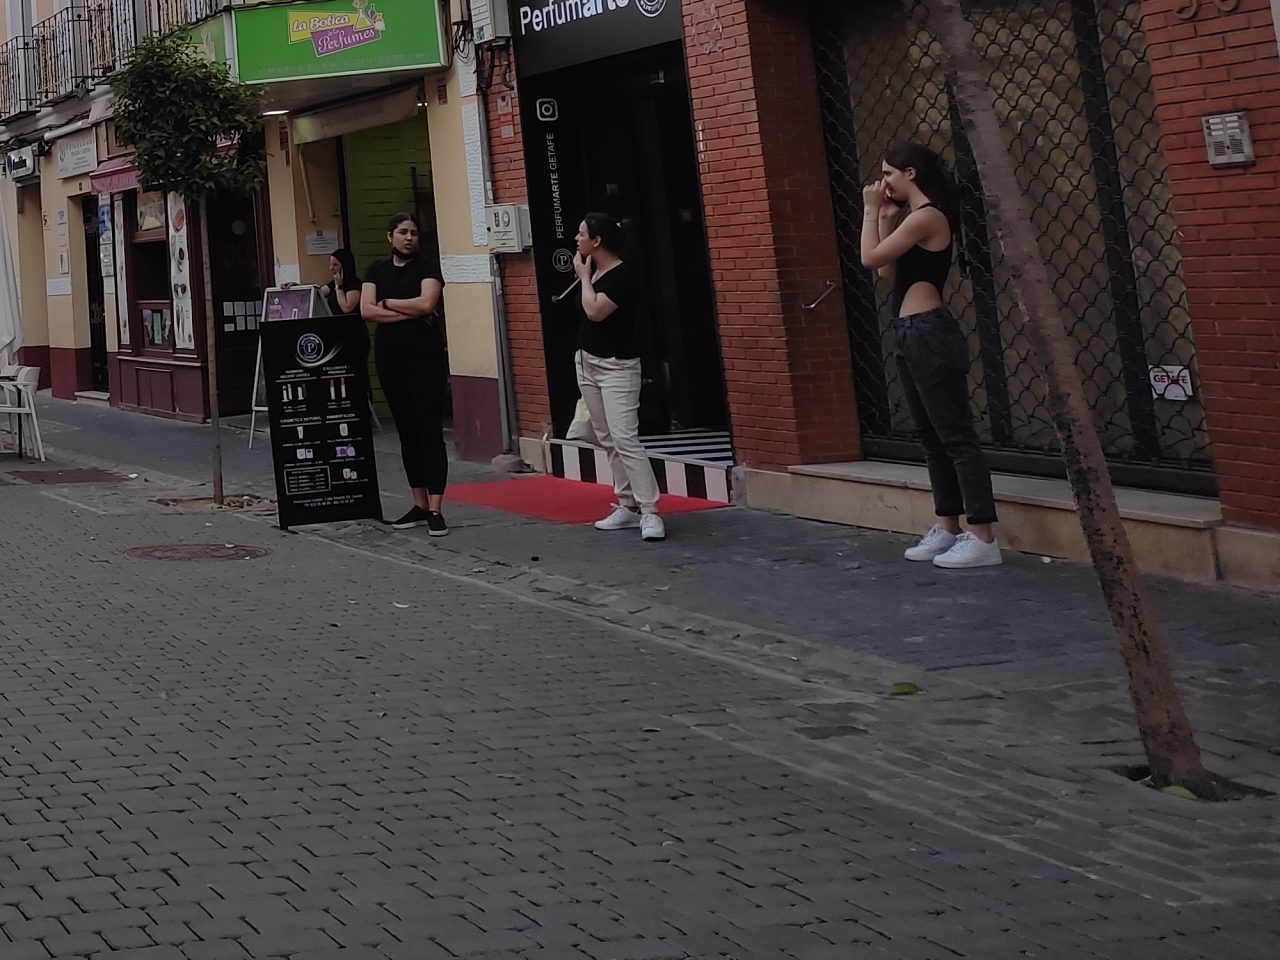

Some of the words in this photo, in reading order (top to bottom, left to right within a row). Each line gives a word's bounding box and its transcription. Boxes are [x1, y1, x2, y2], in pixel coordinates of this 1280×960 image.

[287, 20, 302, 32] La
[304, 14, 345, 30] Botica
[313, 28, 370, 53] Perfumes
[546, 132, 558, 171] GETAFE
[550, 171, 565, 239] PERFUMARTE
